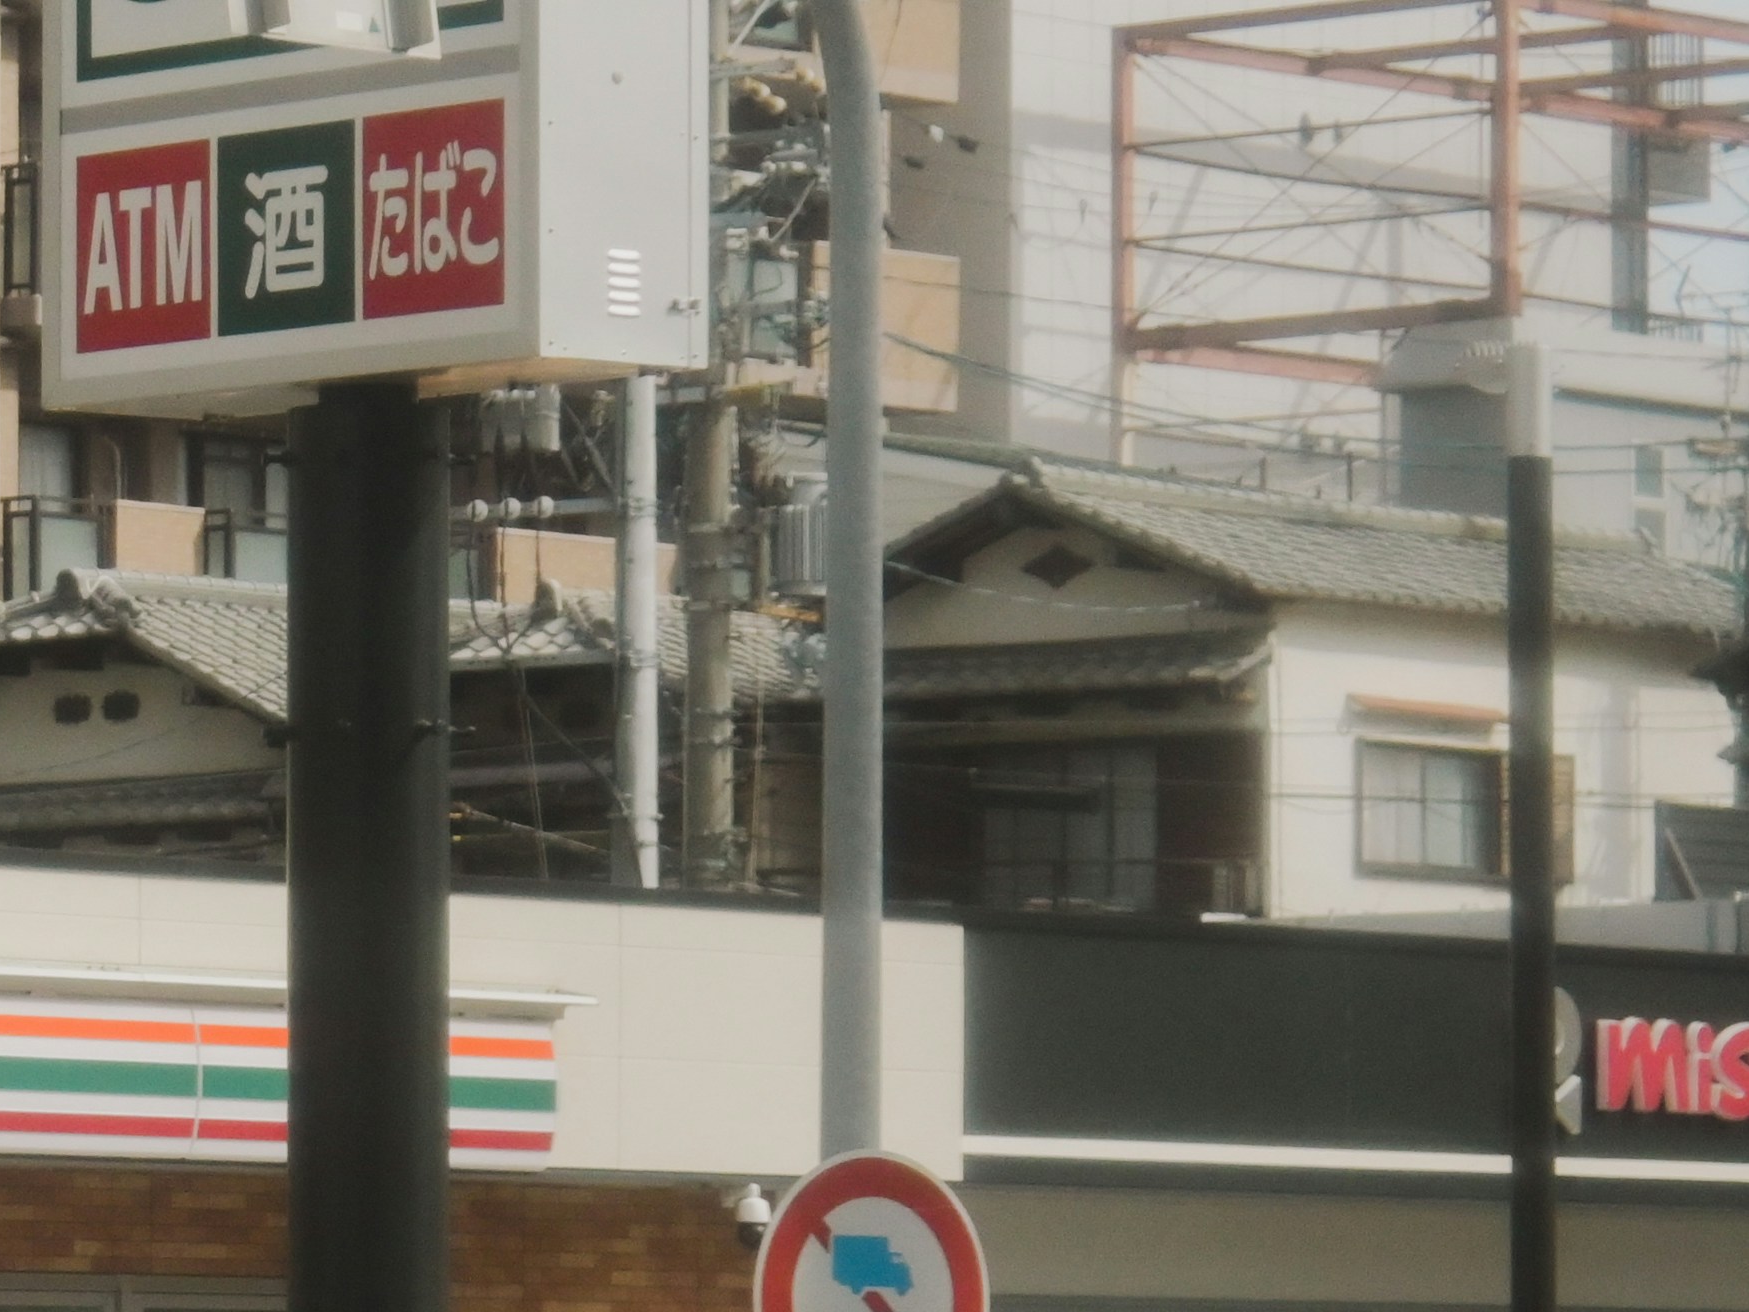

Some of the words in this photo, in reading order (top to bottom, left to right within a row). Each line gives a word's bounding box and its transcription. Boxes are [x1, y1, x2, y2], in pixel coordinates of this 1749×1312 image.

[84, 180, 203, 314] ATM
[245, 164, 328, 300] 酒
[369, 141, 499, 280] たばこ
